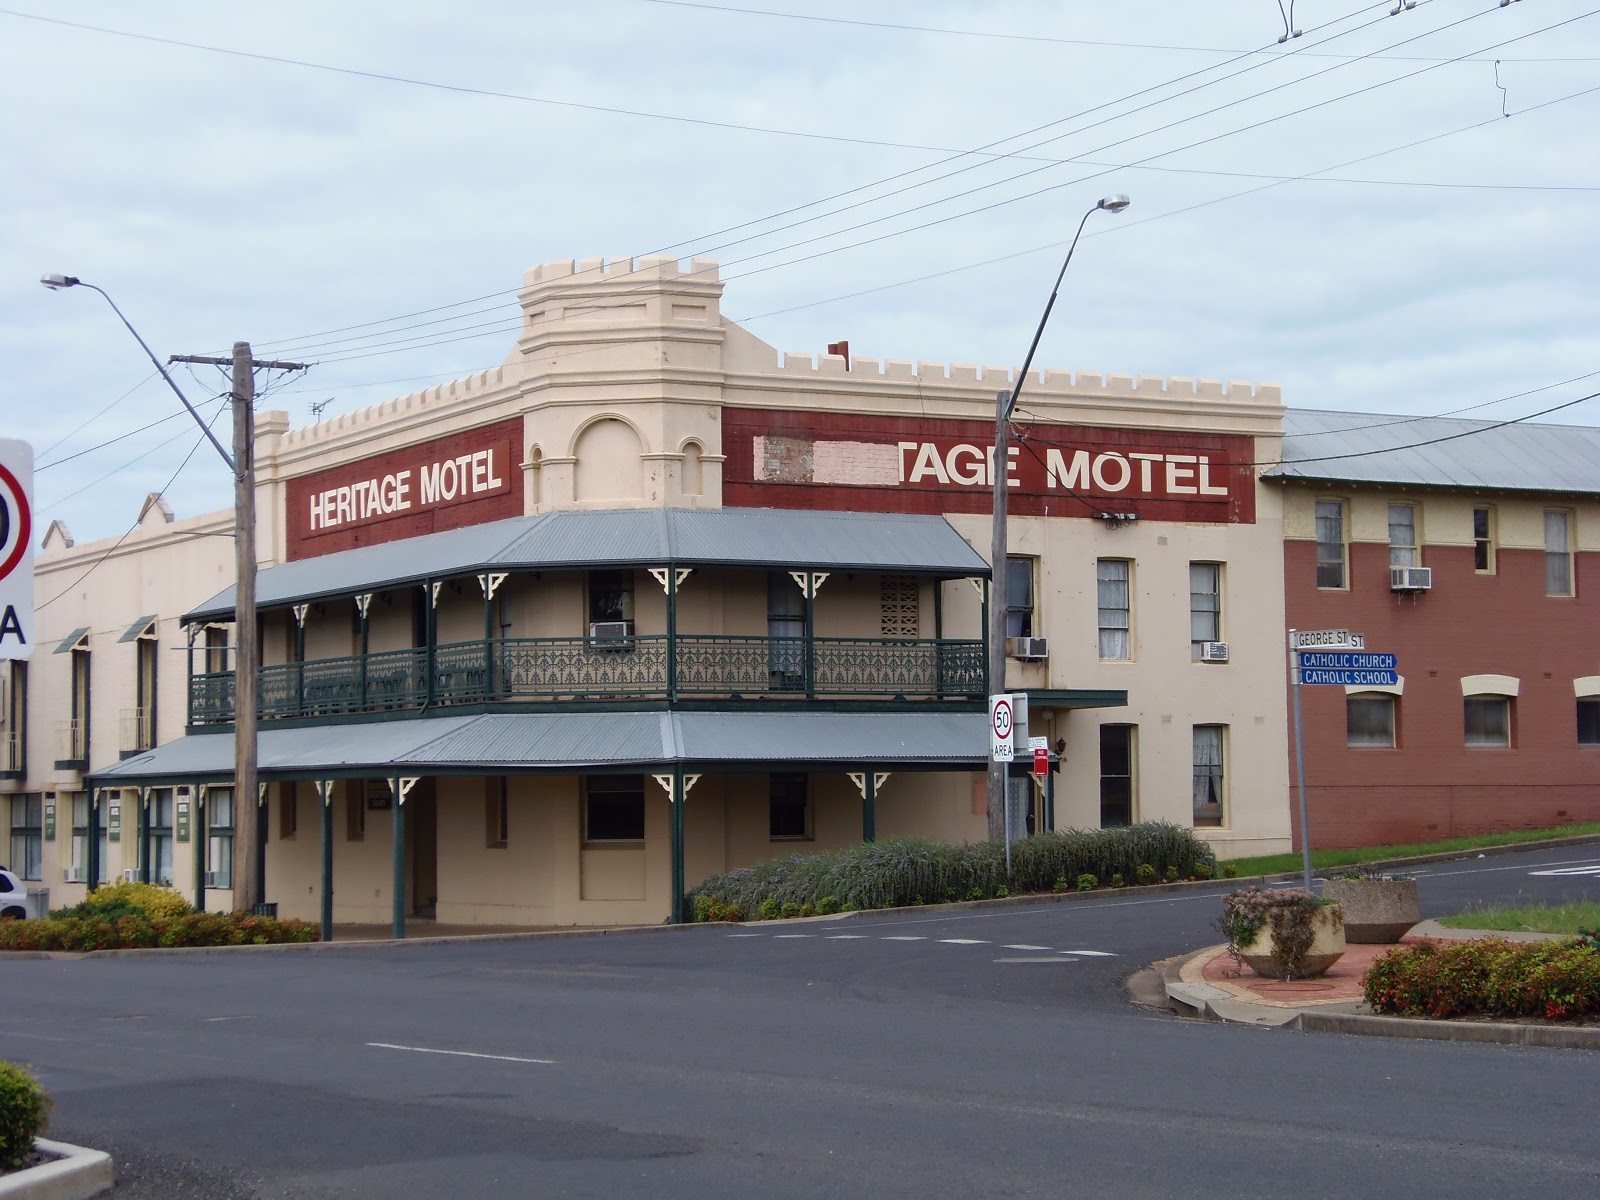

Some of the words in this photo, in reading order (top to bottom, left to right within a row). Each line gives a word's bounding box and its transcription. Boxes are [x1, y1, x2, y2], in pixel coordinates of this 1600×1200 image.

[1046, 448, 1228, 495] MOTEL
[310, 470, 411, 530] HERITAGE
[420, 449, 502, 505] MOTEL
[1298, 632, 1334, 646] GEORGE
[1336, 631, 1348, 644] ST
[1350, 635, 1364, 648] ST
[1303, 653, 1350, 667] CATHOLIC
[1352, 655, 1393, 668] CHURCH
[1305, 670, 1351, 683] CATHOLIC
[1354, 671, 1395, 684] SCHOOL
[996, 711, 1009, 728] 50
[994, 745, 1013, 756] AREA
